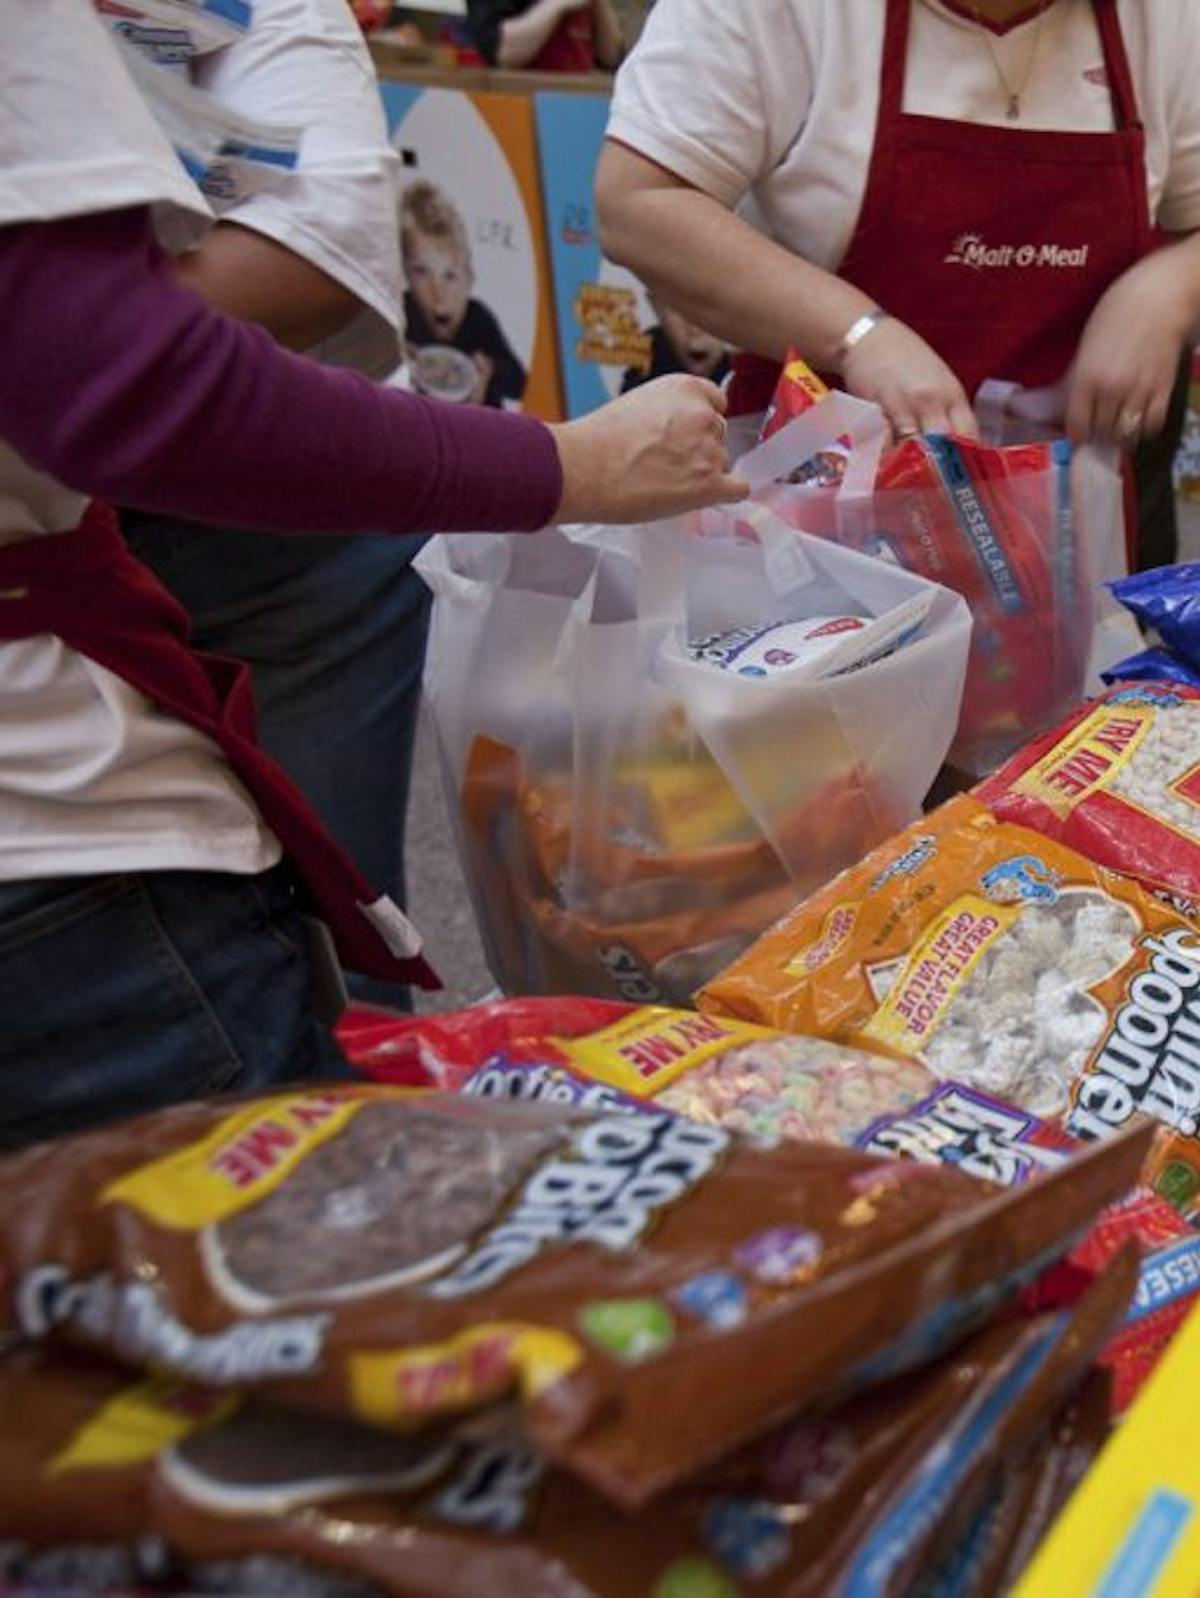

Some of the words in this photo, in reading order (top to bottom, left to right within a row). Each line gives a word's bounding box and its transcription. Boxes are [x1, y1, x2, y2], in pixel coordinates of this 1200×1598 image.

[1094, 717, 1145, 753] TRY
[1044, 747, 1113, 796] ME
[931, 911, 975, 960] GREAT
[957, 915, 999, 964] GREAT
[895, 957, 938, 1020] VALUE
[906, 960, 962, 1035] FLAVOR
[619, 1034, 688, 1078] ME
[209, 1119, 298, 1188] ME
